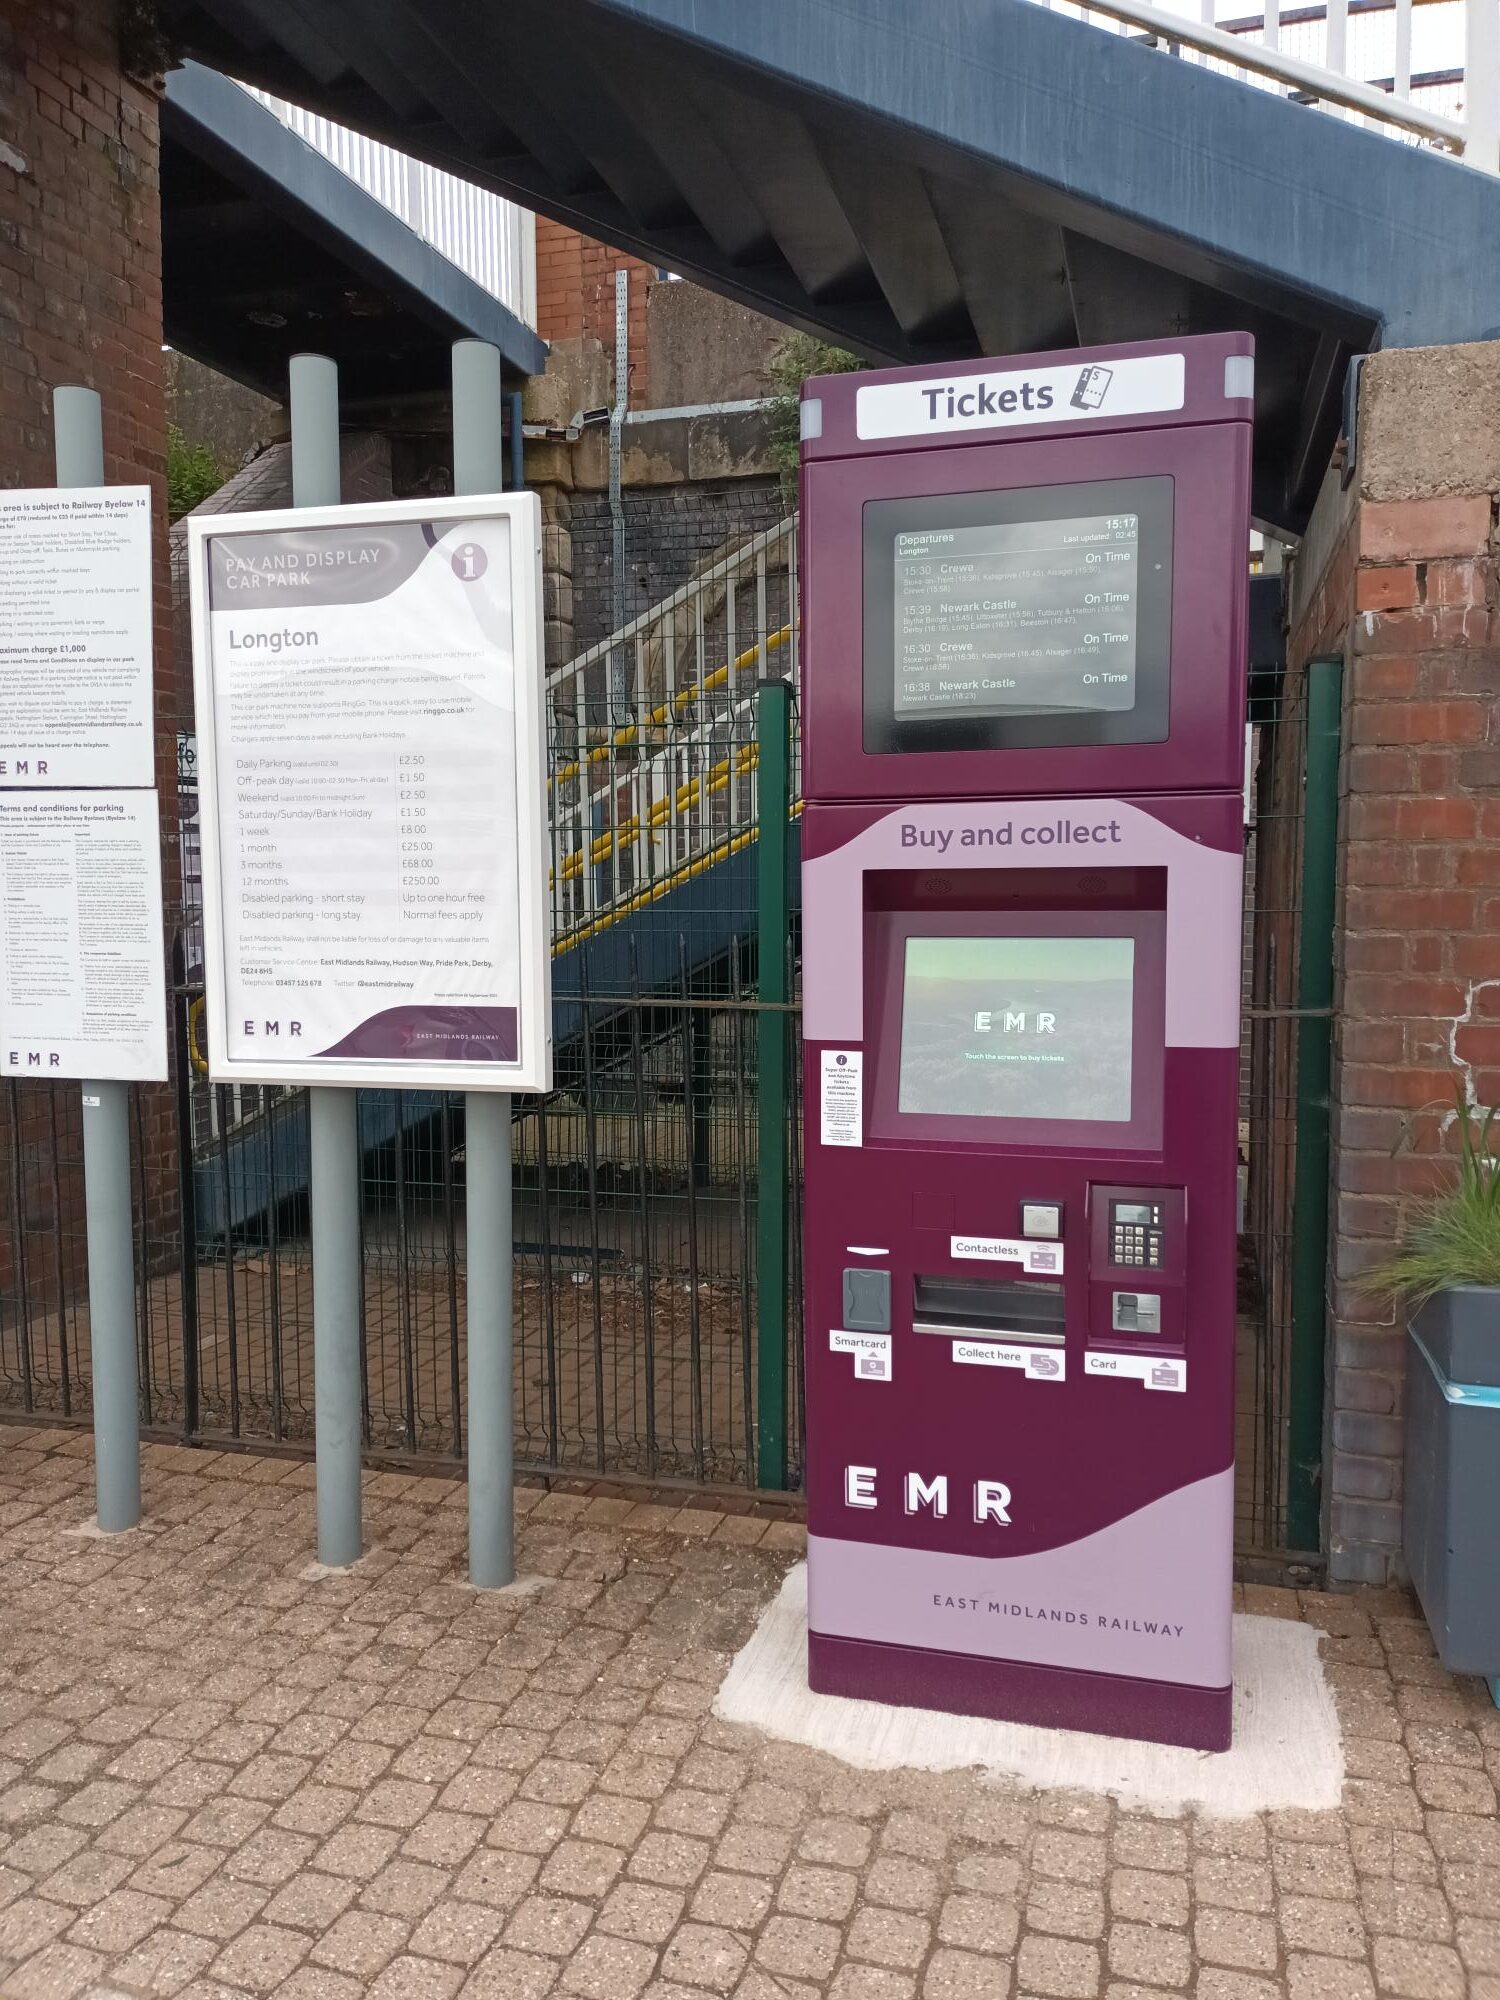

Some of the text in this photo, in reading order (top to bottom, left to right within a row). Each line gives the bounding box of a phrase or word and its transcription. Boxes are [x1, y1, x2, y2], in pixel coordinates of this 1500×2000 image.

[922, 382, 1054, 420] Tickets
[32, 503, 60, 513] subject
[72, 501, 103, 511] Railway
[105, 500, 134, 510] Byelaw
[1105, 518, 1136, 529] 15:17
[900, 534, 954, 546] Departures
[1063, 535, 1078, 543] Last
[1080, 533, 1110, 543] updated
[899, 547, 929, 556] Longton
[226, 549, 380, 572] PAY AND DISPLAY
[1085, 552, 1130, 563] On Time
[905, 565, 932, 576] 15:30
[940, 564, 974, 574] Crewe
[226, 571, 311, 590] CAR PARK
[1085, 592, 1129, 604] On Time
[904, 605, 931, 615] 15:39
[940, 600, 1017, 613] Newark Castle
[229, 628, 319, 652] Longton
[1084, 632, 1128, 644] On Time
[0, 645, 86, 655] aximum charge £1,000
[904, 644, 931, 654] 16:30
[940, 643, 973, 652] Crewe
[1083, 672, 1128, 684] On Time
[904, 682, 930, 693] 16:38
[940, 679, 1016, 691] Newark Castle
[236, 759, 291, 771] Daily Parking
[399, 755, 425, 765] £2.50
[0, 760, 48, 775] EMR
[237, 776, 295, 787] Off-peak day
[399, 772, 425, 782] £1.50
[238, 792, 279, 802] Weekend
[400, 790, 426, 800] £2.50
[23, 804, 38, 812] and
[40, 804, 78, 812] conditions
[80, 804, 91, 812] for
[93, 804, 124, 814] parking
[238, 808, 372, 820] Saturday/Sunday/Bank Holiday
[400, 807, 426, 817] £1.50
[247, 827, 270, 836] week
[401, 825, 426, 834] £8.00
[900, 820, 1122, 853] Buy and collect
[248, 844, 276, 853] month
[402, 842, 433, 851] £25.00
[248, 860, 283, 869] months
[402, 859, 433, 868] £68.00
[242, 877, 289, 886] 12 months
[402, 876, 440, 885] £250.00
[242, 893, 365, 905] Disabled parking short stay
[402, 893, 486, 904] Up to one hour free
[242, 910, 361, 921] Disabled parking long stay
[403, 910, 484, 921] Normal fees apply
[244, 1020, 302, 1036] EMR
[974, 1011, 1056, 1034] EMR
[9, 1051, 60, 1066] EMR
[964, 1052, 984, 1060] Touch
[1028, 1054, 1040, 1063] buy
[956, 1242, 1019, 1257] Contactless
[835, 1336, 887, 1351] Smartcard
[958, 1347, 1022, 1362] Collect here
[1090, 1358, 1117, 1370] Card
[844, 1464, 1013, 1527] EMR
[933, 1594, 1185, 1638] EAST MIDLANDS RAILWAY
